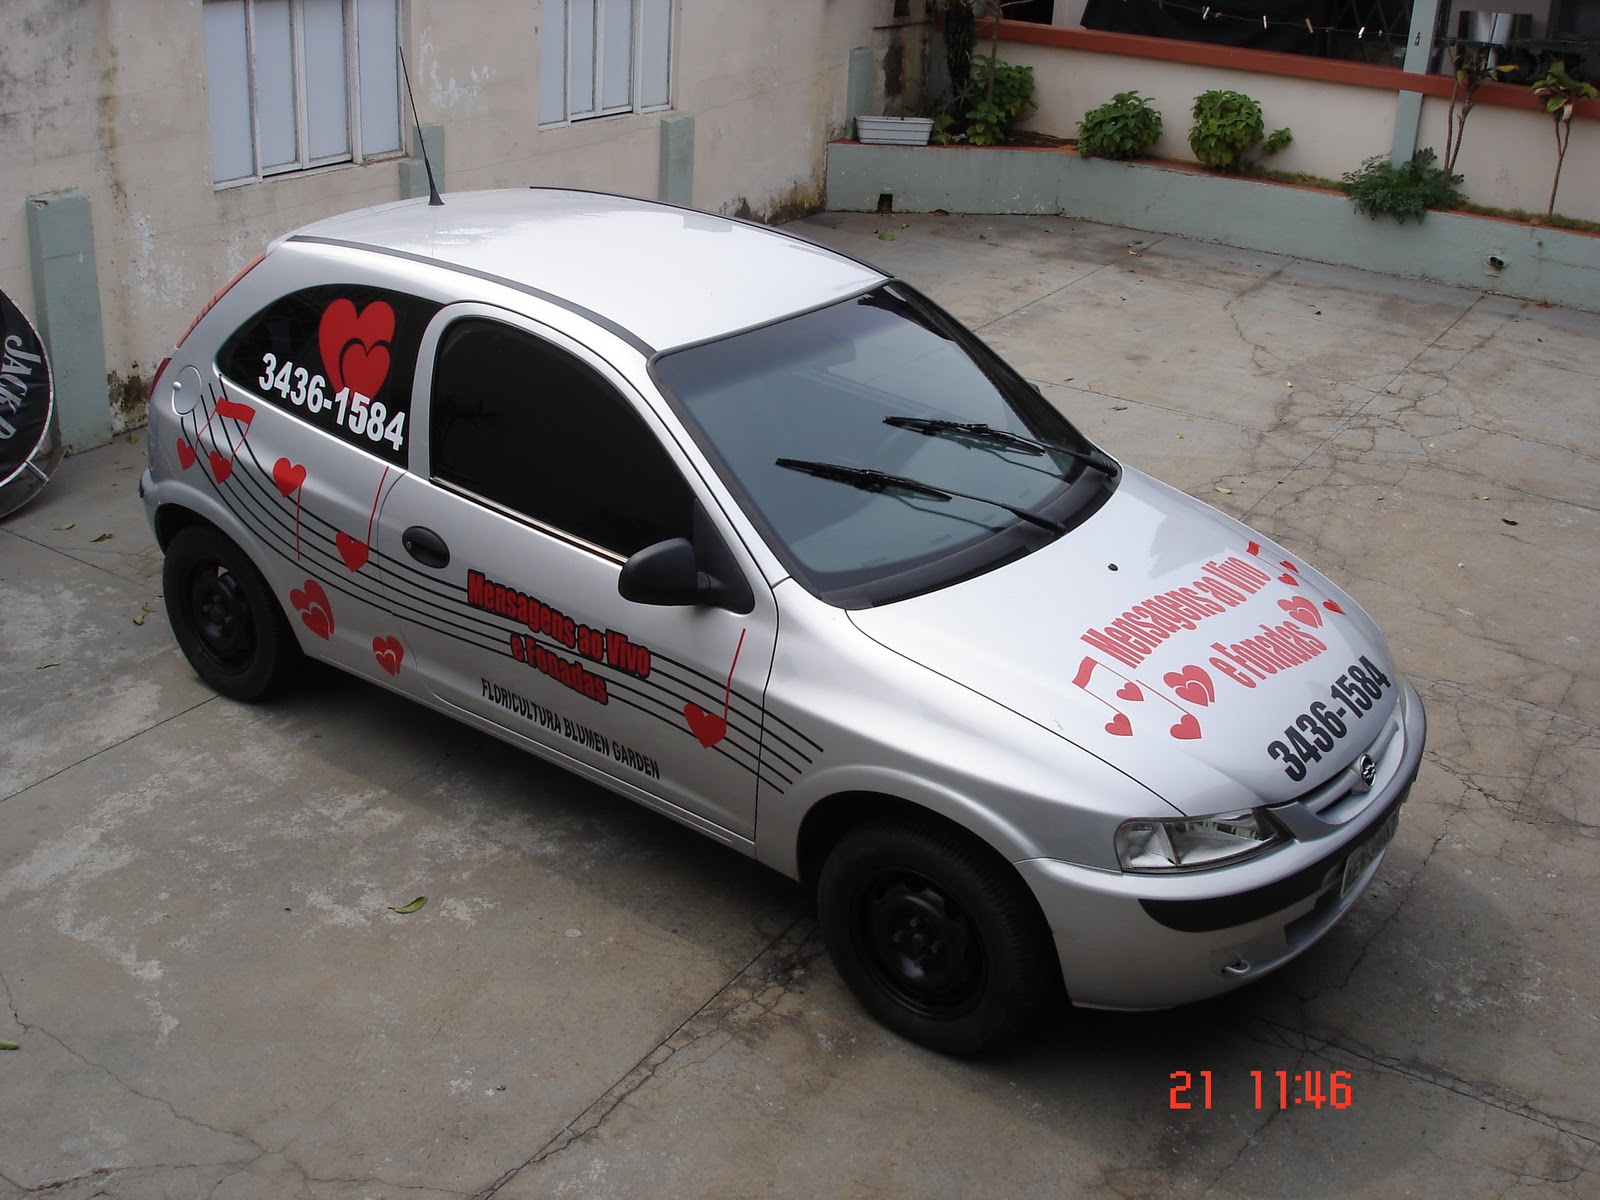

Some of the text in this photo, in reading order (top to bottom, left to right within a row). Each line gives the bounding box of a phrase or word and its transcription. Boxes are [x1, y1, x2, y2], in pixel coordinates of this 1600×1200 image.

[0, 335, 41, 414] JACK
[258, 352, 406, 451] 3436-1584
[467, 569, 652, 680] Mensagens ao Vivo
[1079, 556, 1272, 670] Mensagens ao Vivo
[1208, 620, 1328, 689] e Fonadas
[510, 632, 609, 706] e Fonadas
[1266, 654, 1393, 783] 3436-1584
[481, 677, 660, 780] FLORICULTURA BLUMEN GARDEN
